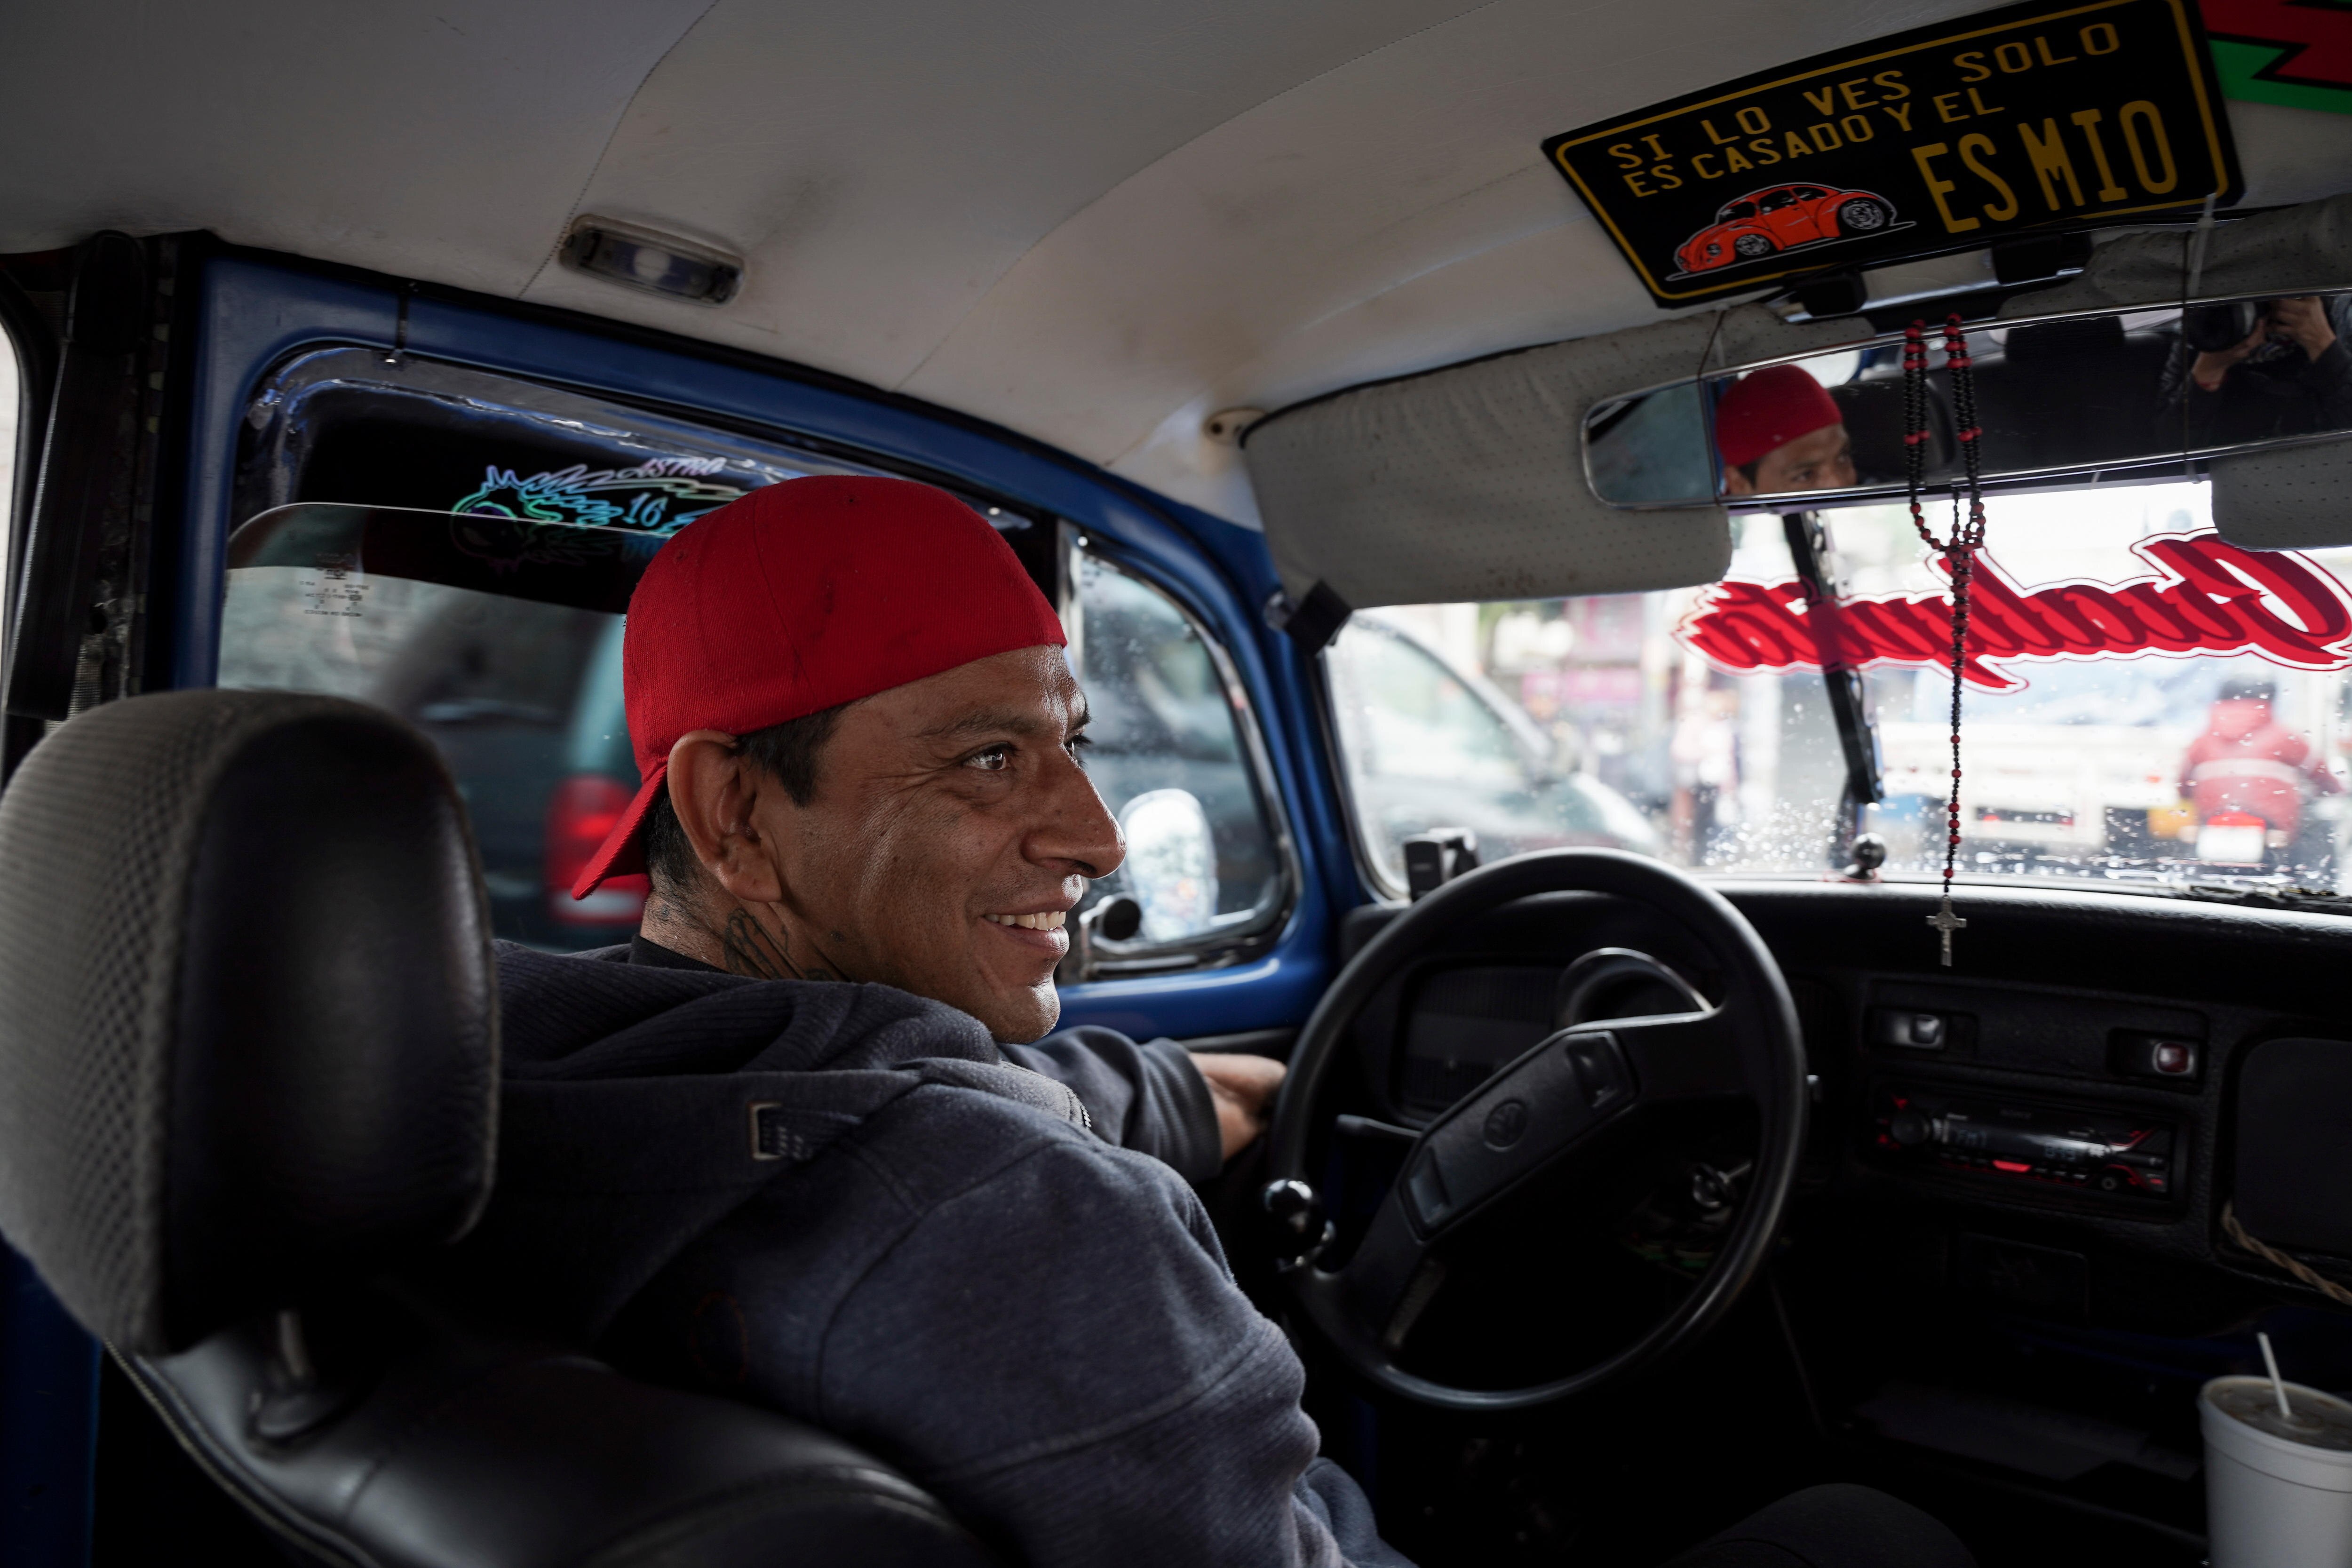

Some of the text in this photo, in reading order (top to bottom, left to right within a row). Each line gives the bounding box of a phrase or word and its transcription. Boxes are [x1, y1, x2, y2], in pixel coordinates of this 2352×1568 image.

[1608, 22, 2121, 169] SI LO VES SOLO
[1623, 89, 2004, 198] ES CASADO Y EL
[1912, 100, 2178, 233] ES MIO
